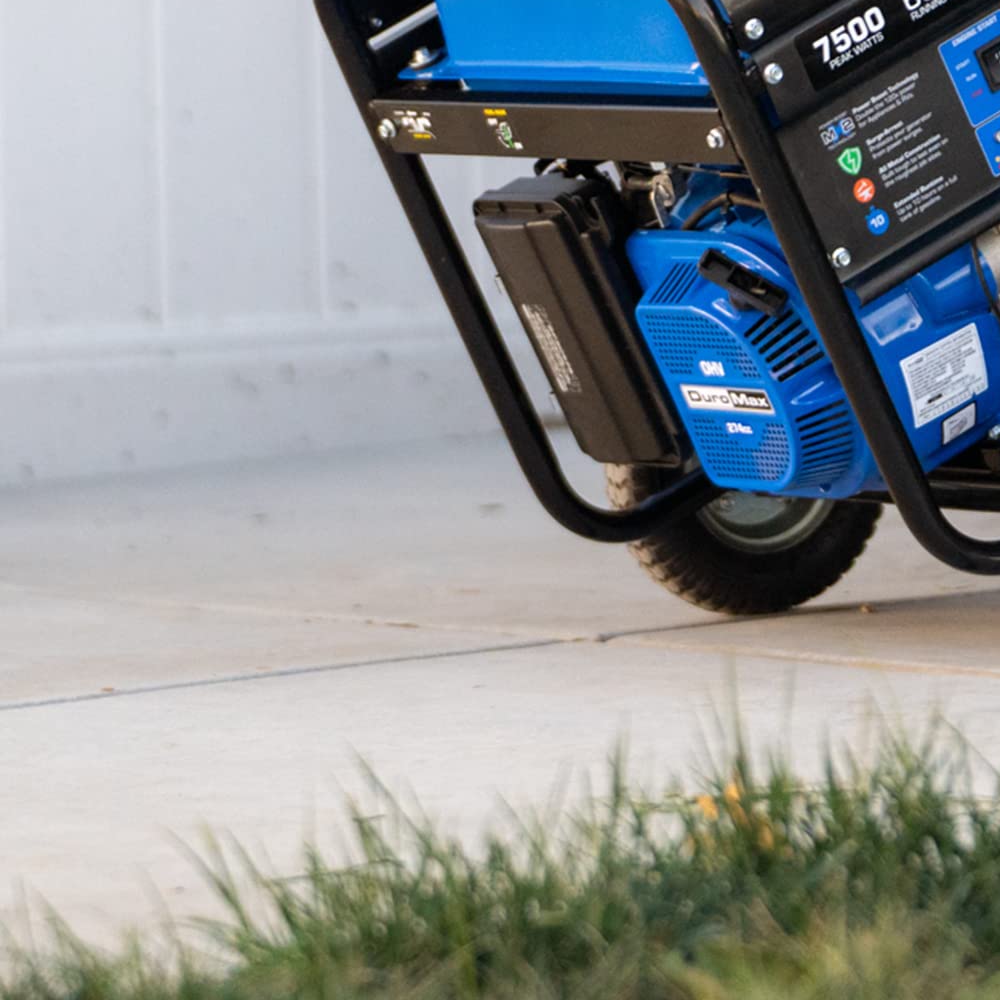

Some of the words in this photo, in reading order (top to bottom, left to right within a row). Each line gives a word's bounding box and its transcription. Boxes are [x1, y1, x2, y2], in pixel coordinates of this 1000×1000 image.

[812, 6, 886, 64] 7500
[951, 28, 977, 47] ENGINE
[976, 15, 997, 32] START
[828, 52, 855, 71] PEAK
[853, 31, 885, 55] WATTS
[870, 214, 885, 228] 10
[699, 360, 725, 377] OHV
[687, 390, 769, 408] DuroMax
